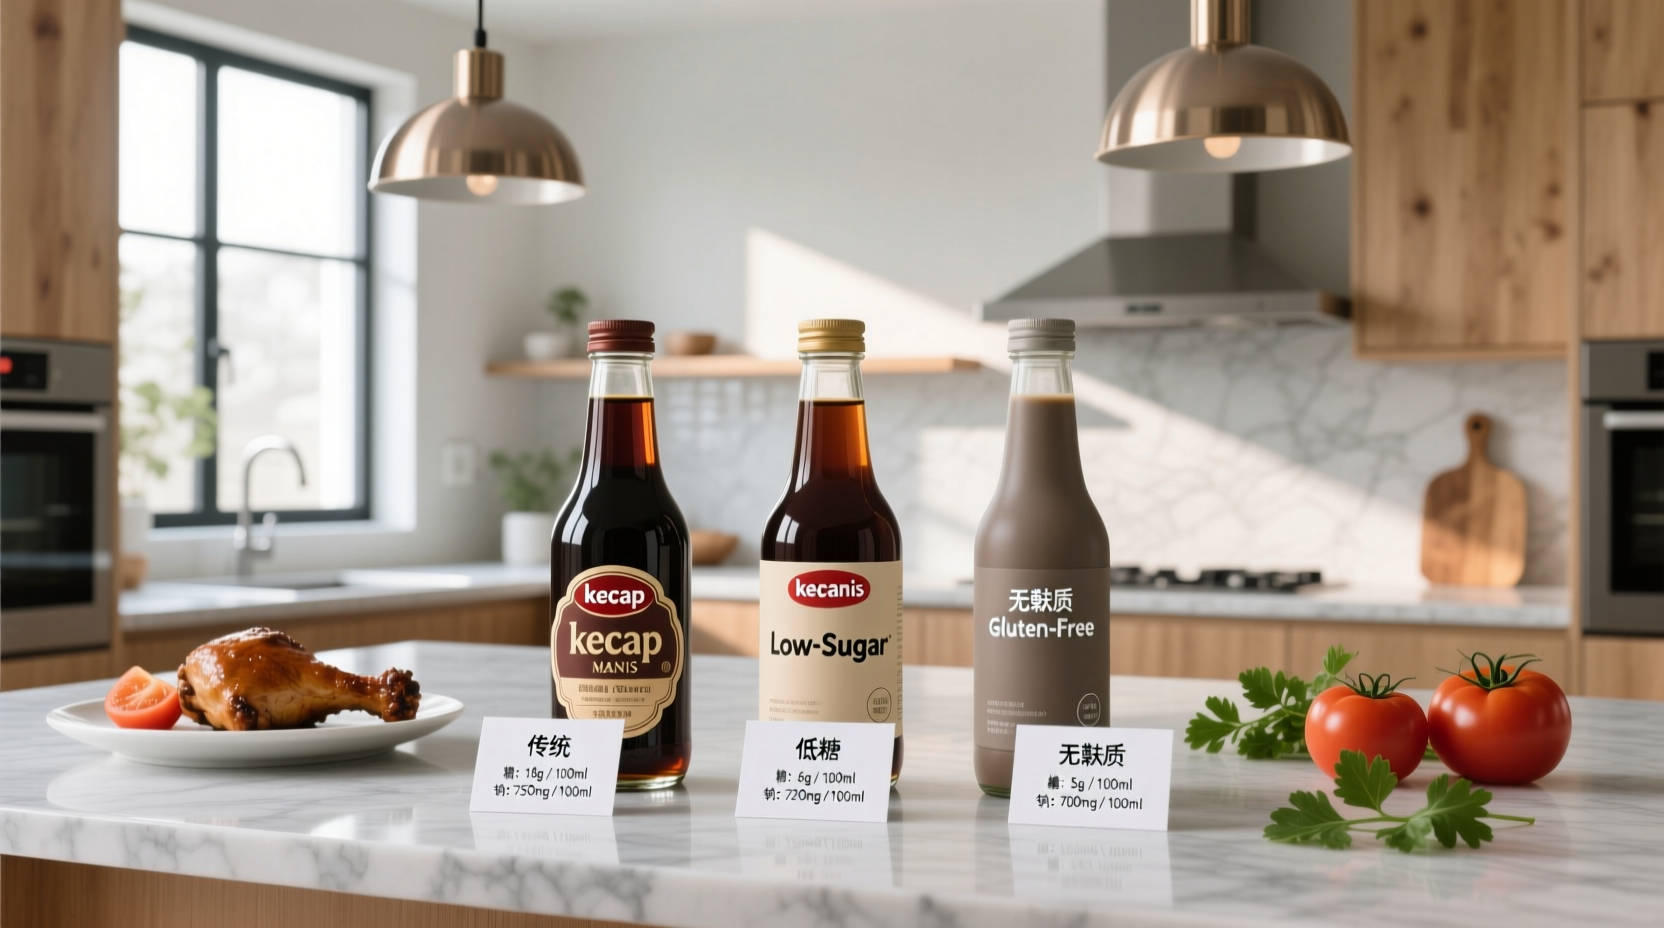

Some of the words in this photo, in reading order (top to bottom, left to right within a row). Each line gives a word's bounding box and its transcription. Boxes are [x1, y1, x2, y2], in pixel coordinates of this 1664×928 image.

[584, 583, 645, 609] kecap
[795, 578, 865, 598] kecanis
[989, 616, 1095, 638] Gluten-Free
[569, 621, 662, 663] kecap
[593, 661, 637, 673] MANIS
[528, 735, 571, 757] 传统
[796, 737, 840, 760] 低糖
[557, 767, 587, 779] 100ml
[798, 772, 811, 786] 6g
[823, 772, 855, 783] 100ml
[1071, 777, 1084, 792] 5g
[1098, 778, 1132, 790] 100ml
